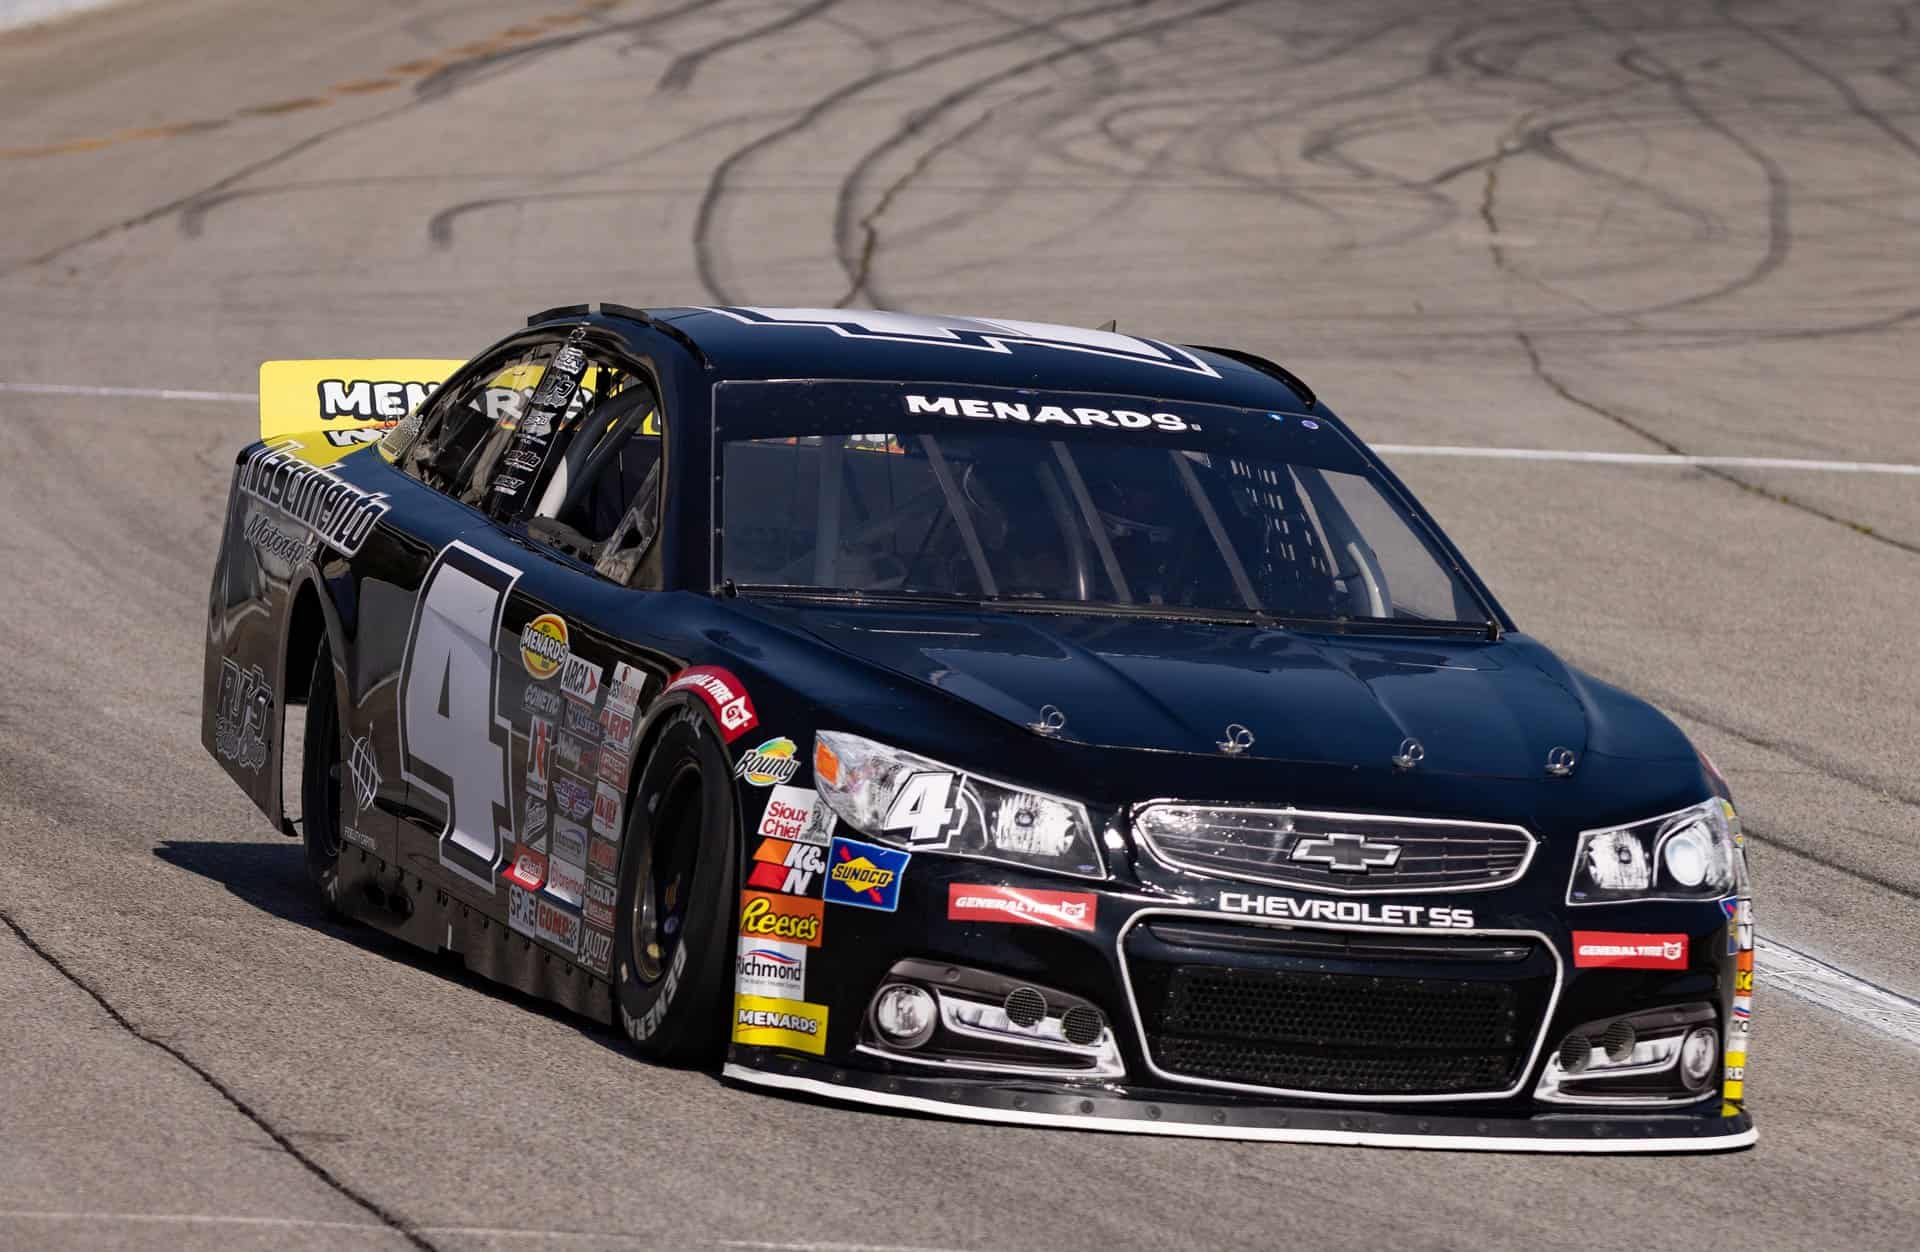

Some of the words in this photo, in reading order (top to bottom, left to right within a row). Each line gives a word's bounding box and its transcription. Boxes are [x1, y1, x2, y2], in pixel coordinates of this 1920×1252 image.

[904, 394, 1190, 432] MENARDS
[521, 625, 569, 665] MENARDS
[561, 659, 590, 695] ARCA
[704, 679, 736, 705] TIRE
[401, 545, 516, 880] 4
[735, 750, 797, 783] Bounty
[767, 801, 809, 824] Sioux
[882, 772, 958, 846] 4
[762, 819, 802, 840] Chief
[834, 864, 891, 886] SUNOCO
[538, 903, 569, 936] COMP
[740, 897, 819, 940] Reese's
[955, 897, 1029, 911] GENERAL
[1219, 891, 1425, 926] CHEVROLET
[1429, 907, 1474, 928] SS
[583, 926, 611, 962] KLOTZ
[1579, 945, 1638, 956] GENERAL
[736, 955, 802, 981] Richmond
[738, 1009, 817, 1035] MENARDS
